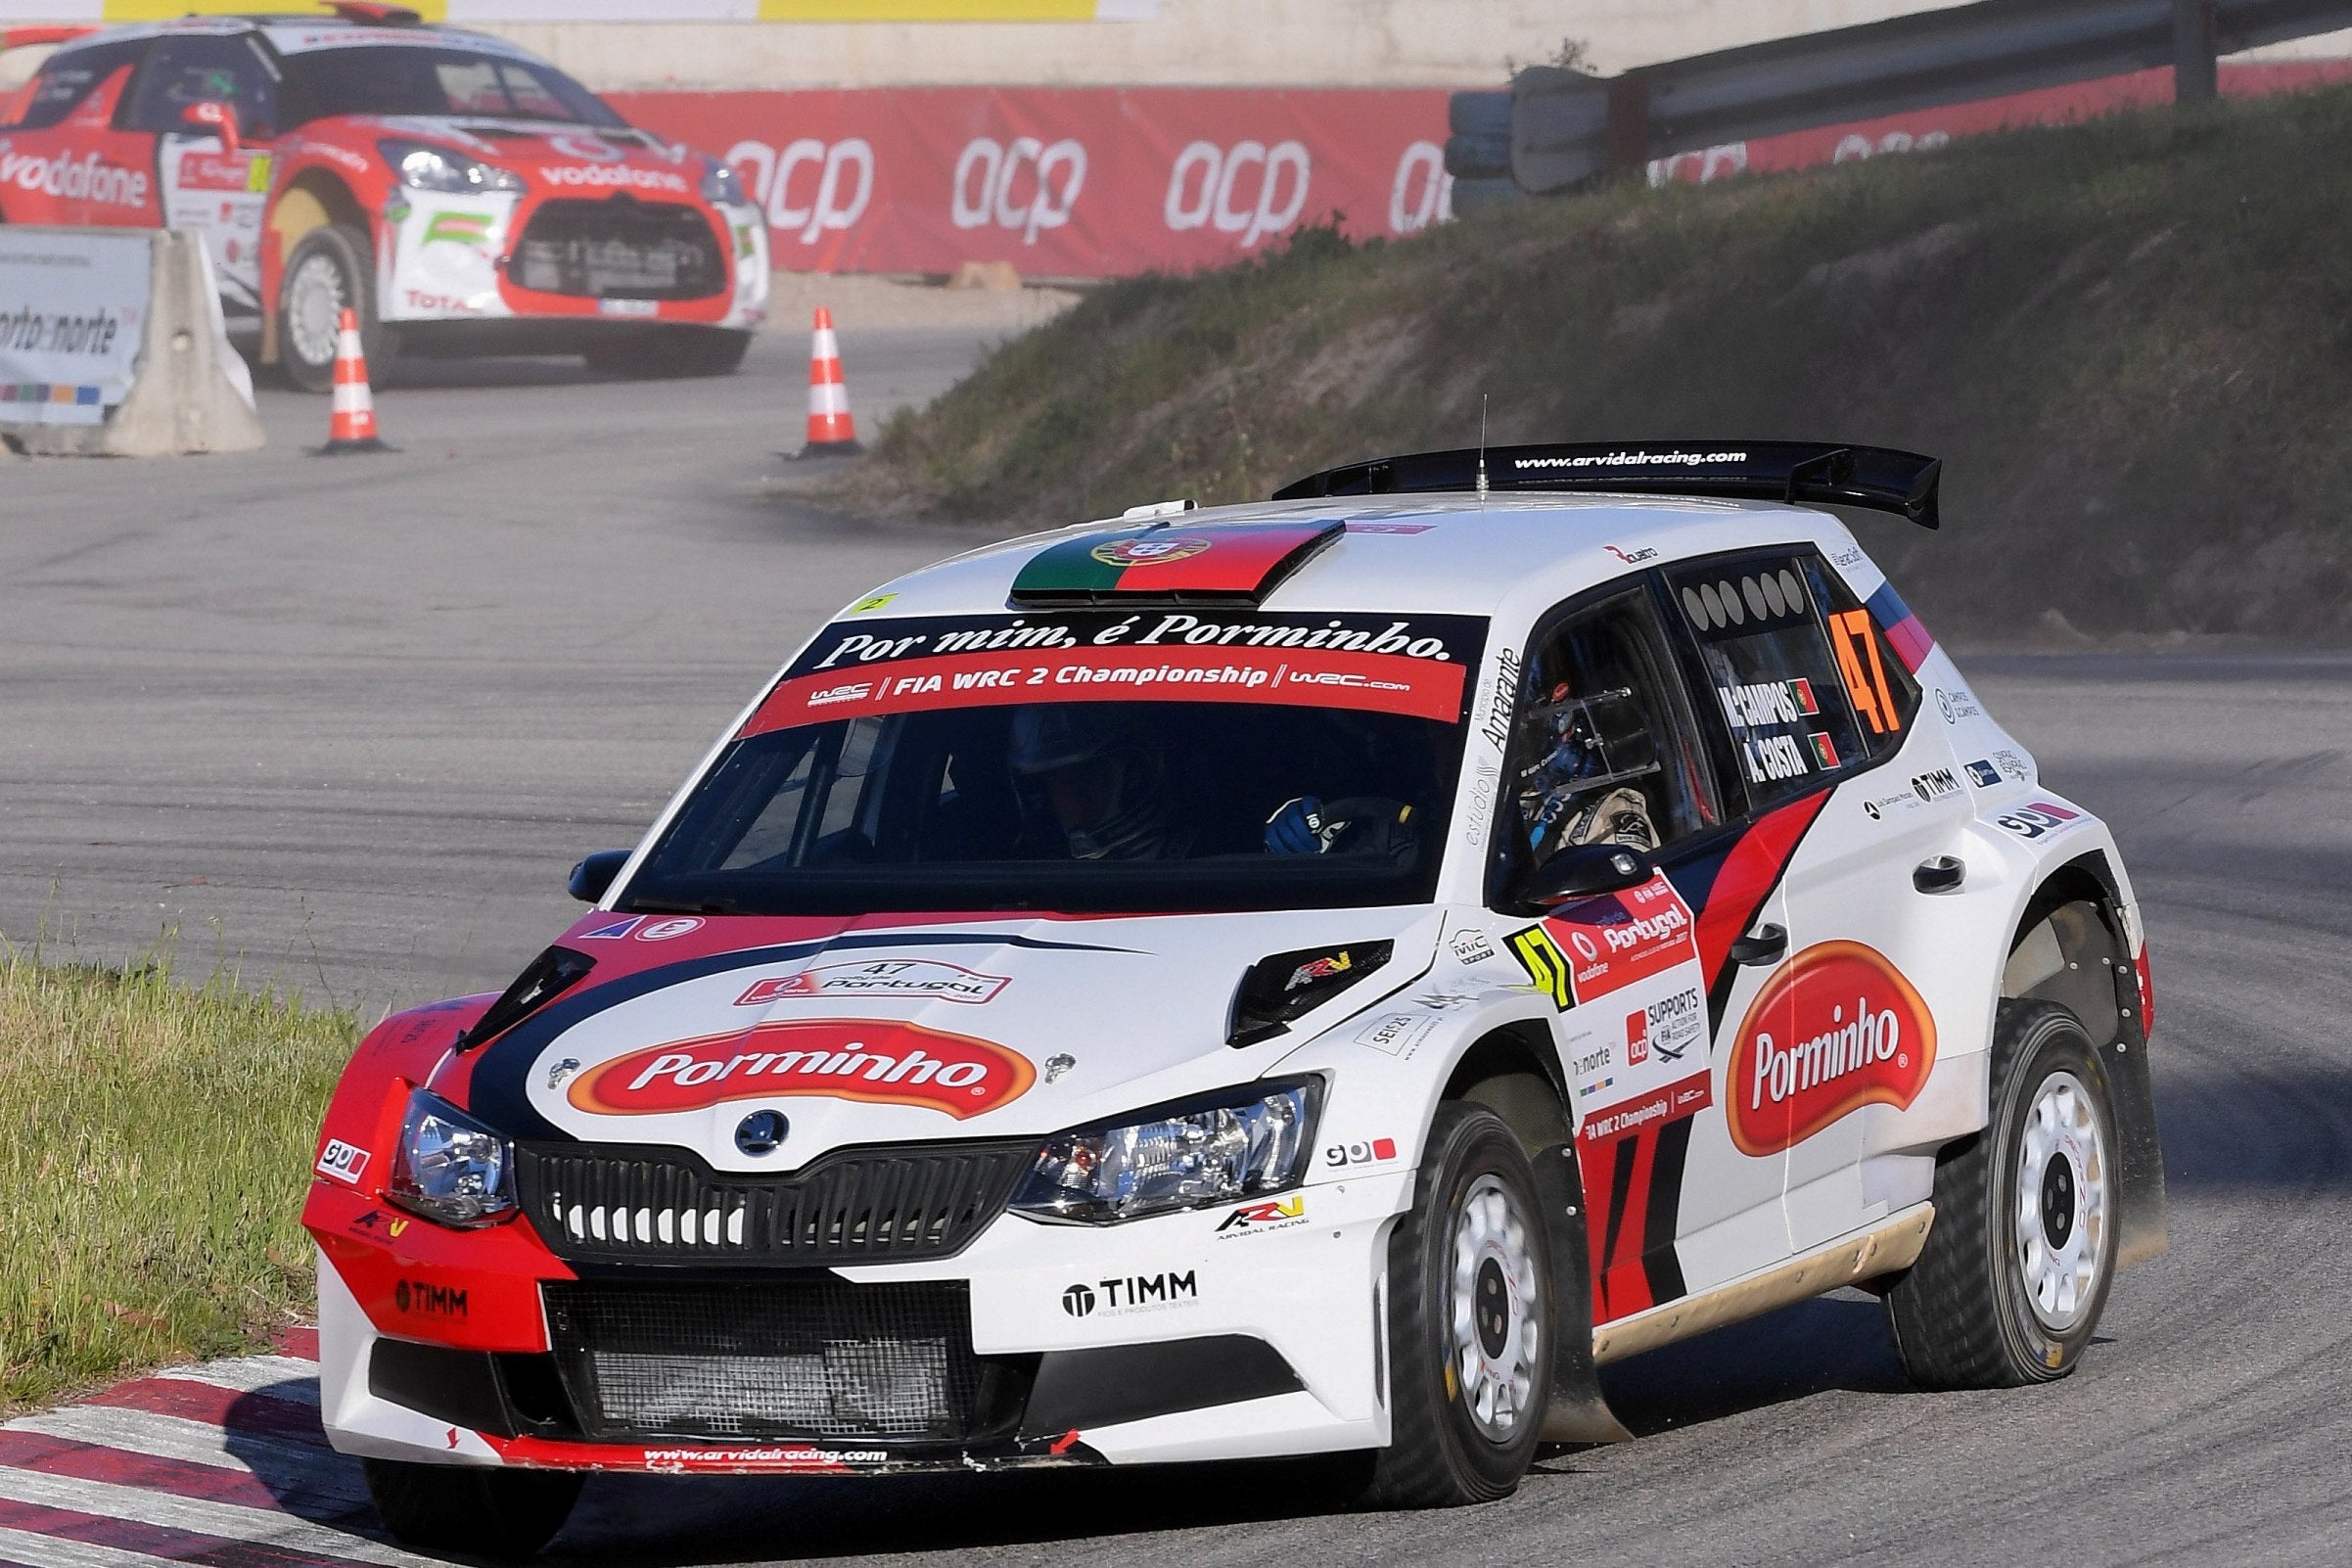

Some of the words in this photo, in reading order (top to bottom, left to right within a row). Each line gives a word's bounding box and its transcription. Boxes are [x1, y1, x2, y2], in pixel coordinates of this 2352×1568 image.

[0, 149, 148, 208] vodafone
[540, 164, 687, 193] vodafone
[1514, 449, 1747, 470] www.arvidalracing.com
[812, 633, 928, 669] Por
[933, 619, 1078, 653] mim,
[1092, 615, 1141, 645] é
[1133, 614, 1452, 661] Porminho.
[893, 675, 943, 696] FIA
[951, 669, 1022, 691] WRC
[1026, 667, 1050, 686] 2
[1054, 665, 1269, 688] Championship
[1828, 608, 1901, 734] 47
[1481, 647, 1521, 754] Amarante
[1735, 681, 1798, 726] CAMPOS
[1758, 734, 1809, 780] COSTA
[1919, 767, 1960, 796] TIMM
[1602, 902, 1688, 954] Portugal
[821, 980, 984, 994] Portugal
[862, 963, 917, 976] 47
[1514, 928, 1569, 1008] 47
[1577, 962, 1609, 984] vodafone
[1648, 987, 1699, 1027] SUPPORTS
[627, 1041, 989, 1091] Porminho
[1752, 995, 1900, 1110] Porminho
[1621, 1098, 1668, 1128] Championship
[1217, 1227, 1266, 1241] ARVIDAL
[1268, 1219, 1310, 1232] RACING
[413, 1280, 468, 1317] TIMM
[1098, 1268, 1198, 1308] TIMM
[644, 1447, 888, 1464] www.arvidalracing.com
